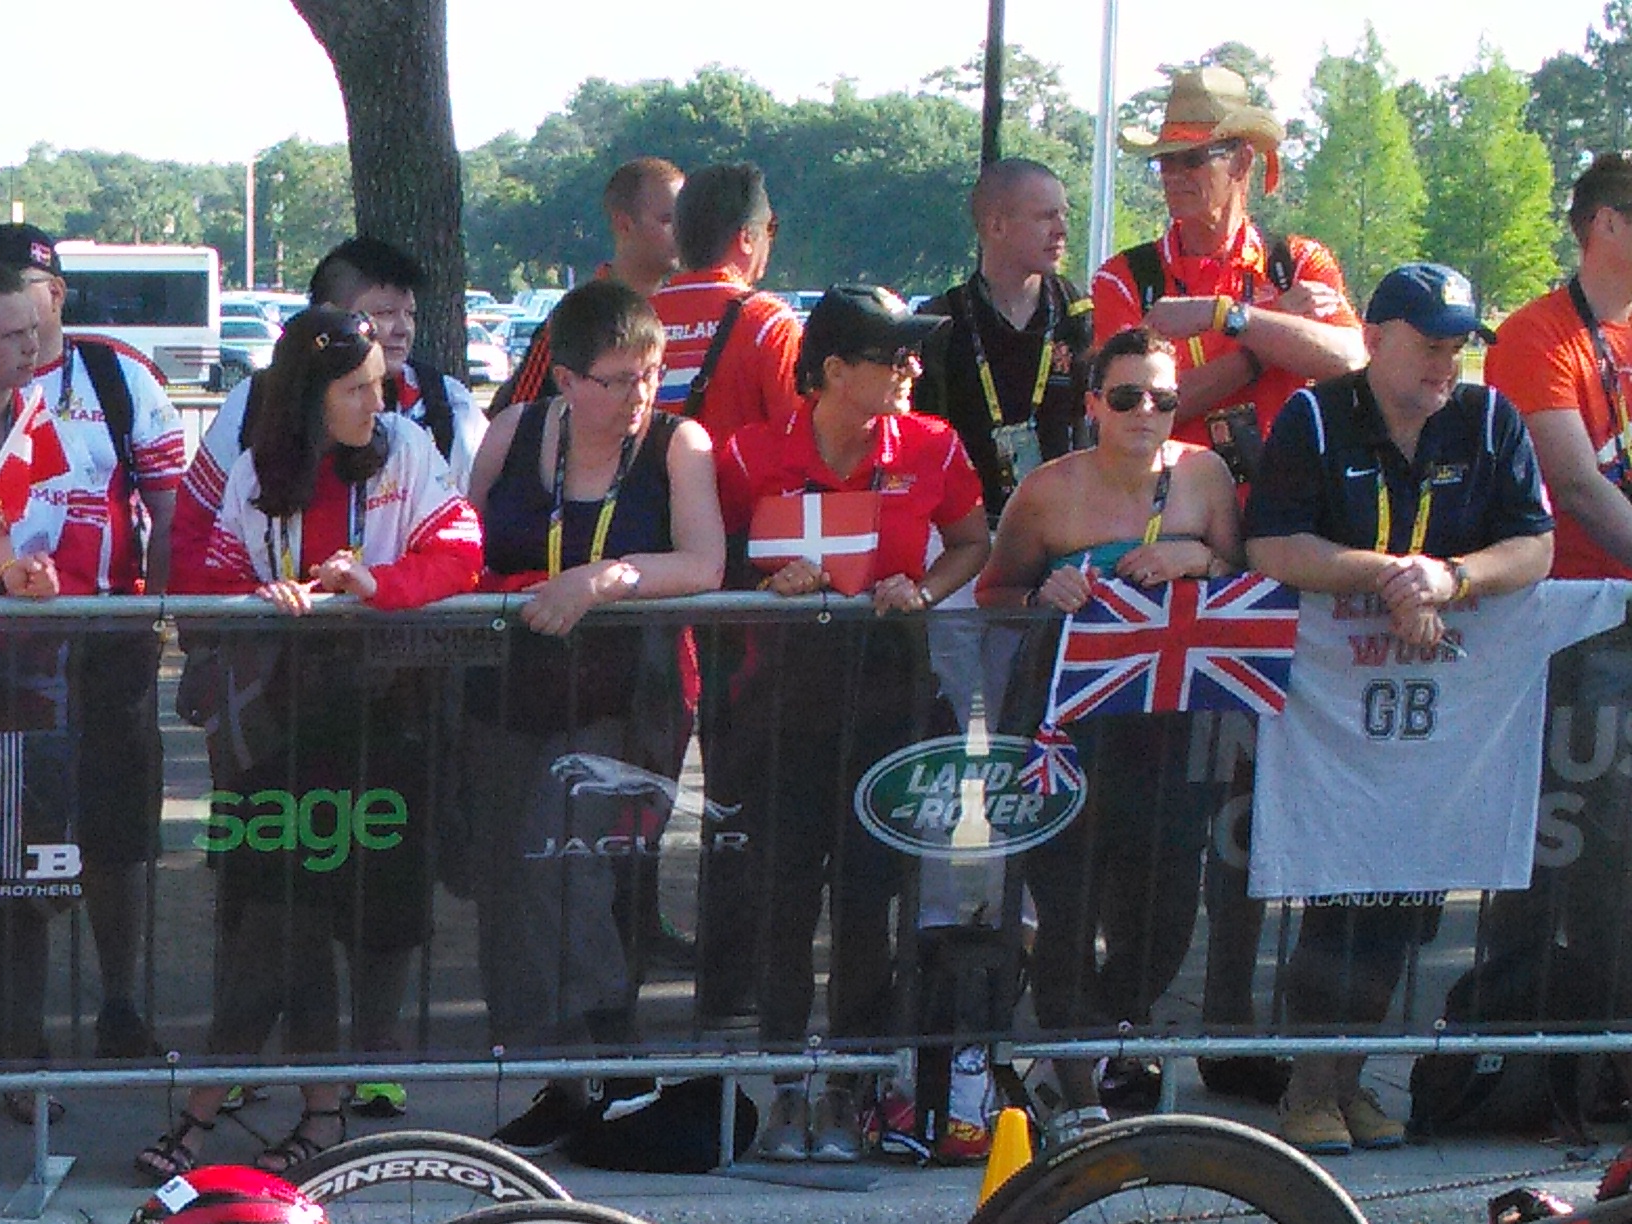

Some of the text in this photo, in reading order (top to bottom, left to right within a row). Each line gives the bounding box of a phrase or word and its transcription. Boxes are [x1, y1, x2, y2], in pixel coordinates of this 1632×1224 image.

[663, 320, 720, 340] ERLAN
[1362, 678, 1439, 740] GB
[906, 762, 1014, 794] LAND
[193, 787, 407, 872] sage
[306, 1160, 524, 1201] PINERGY
